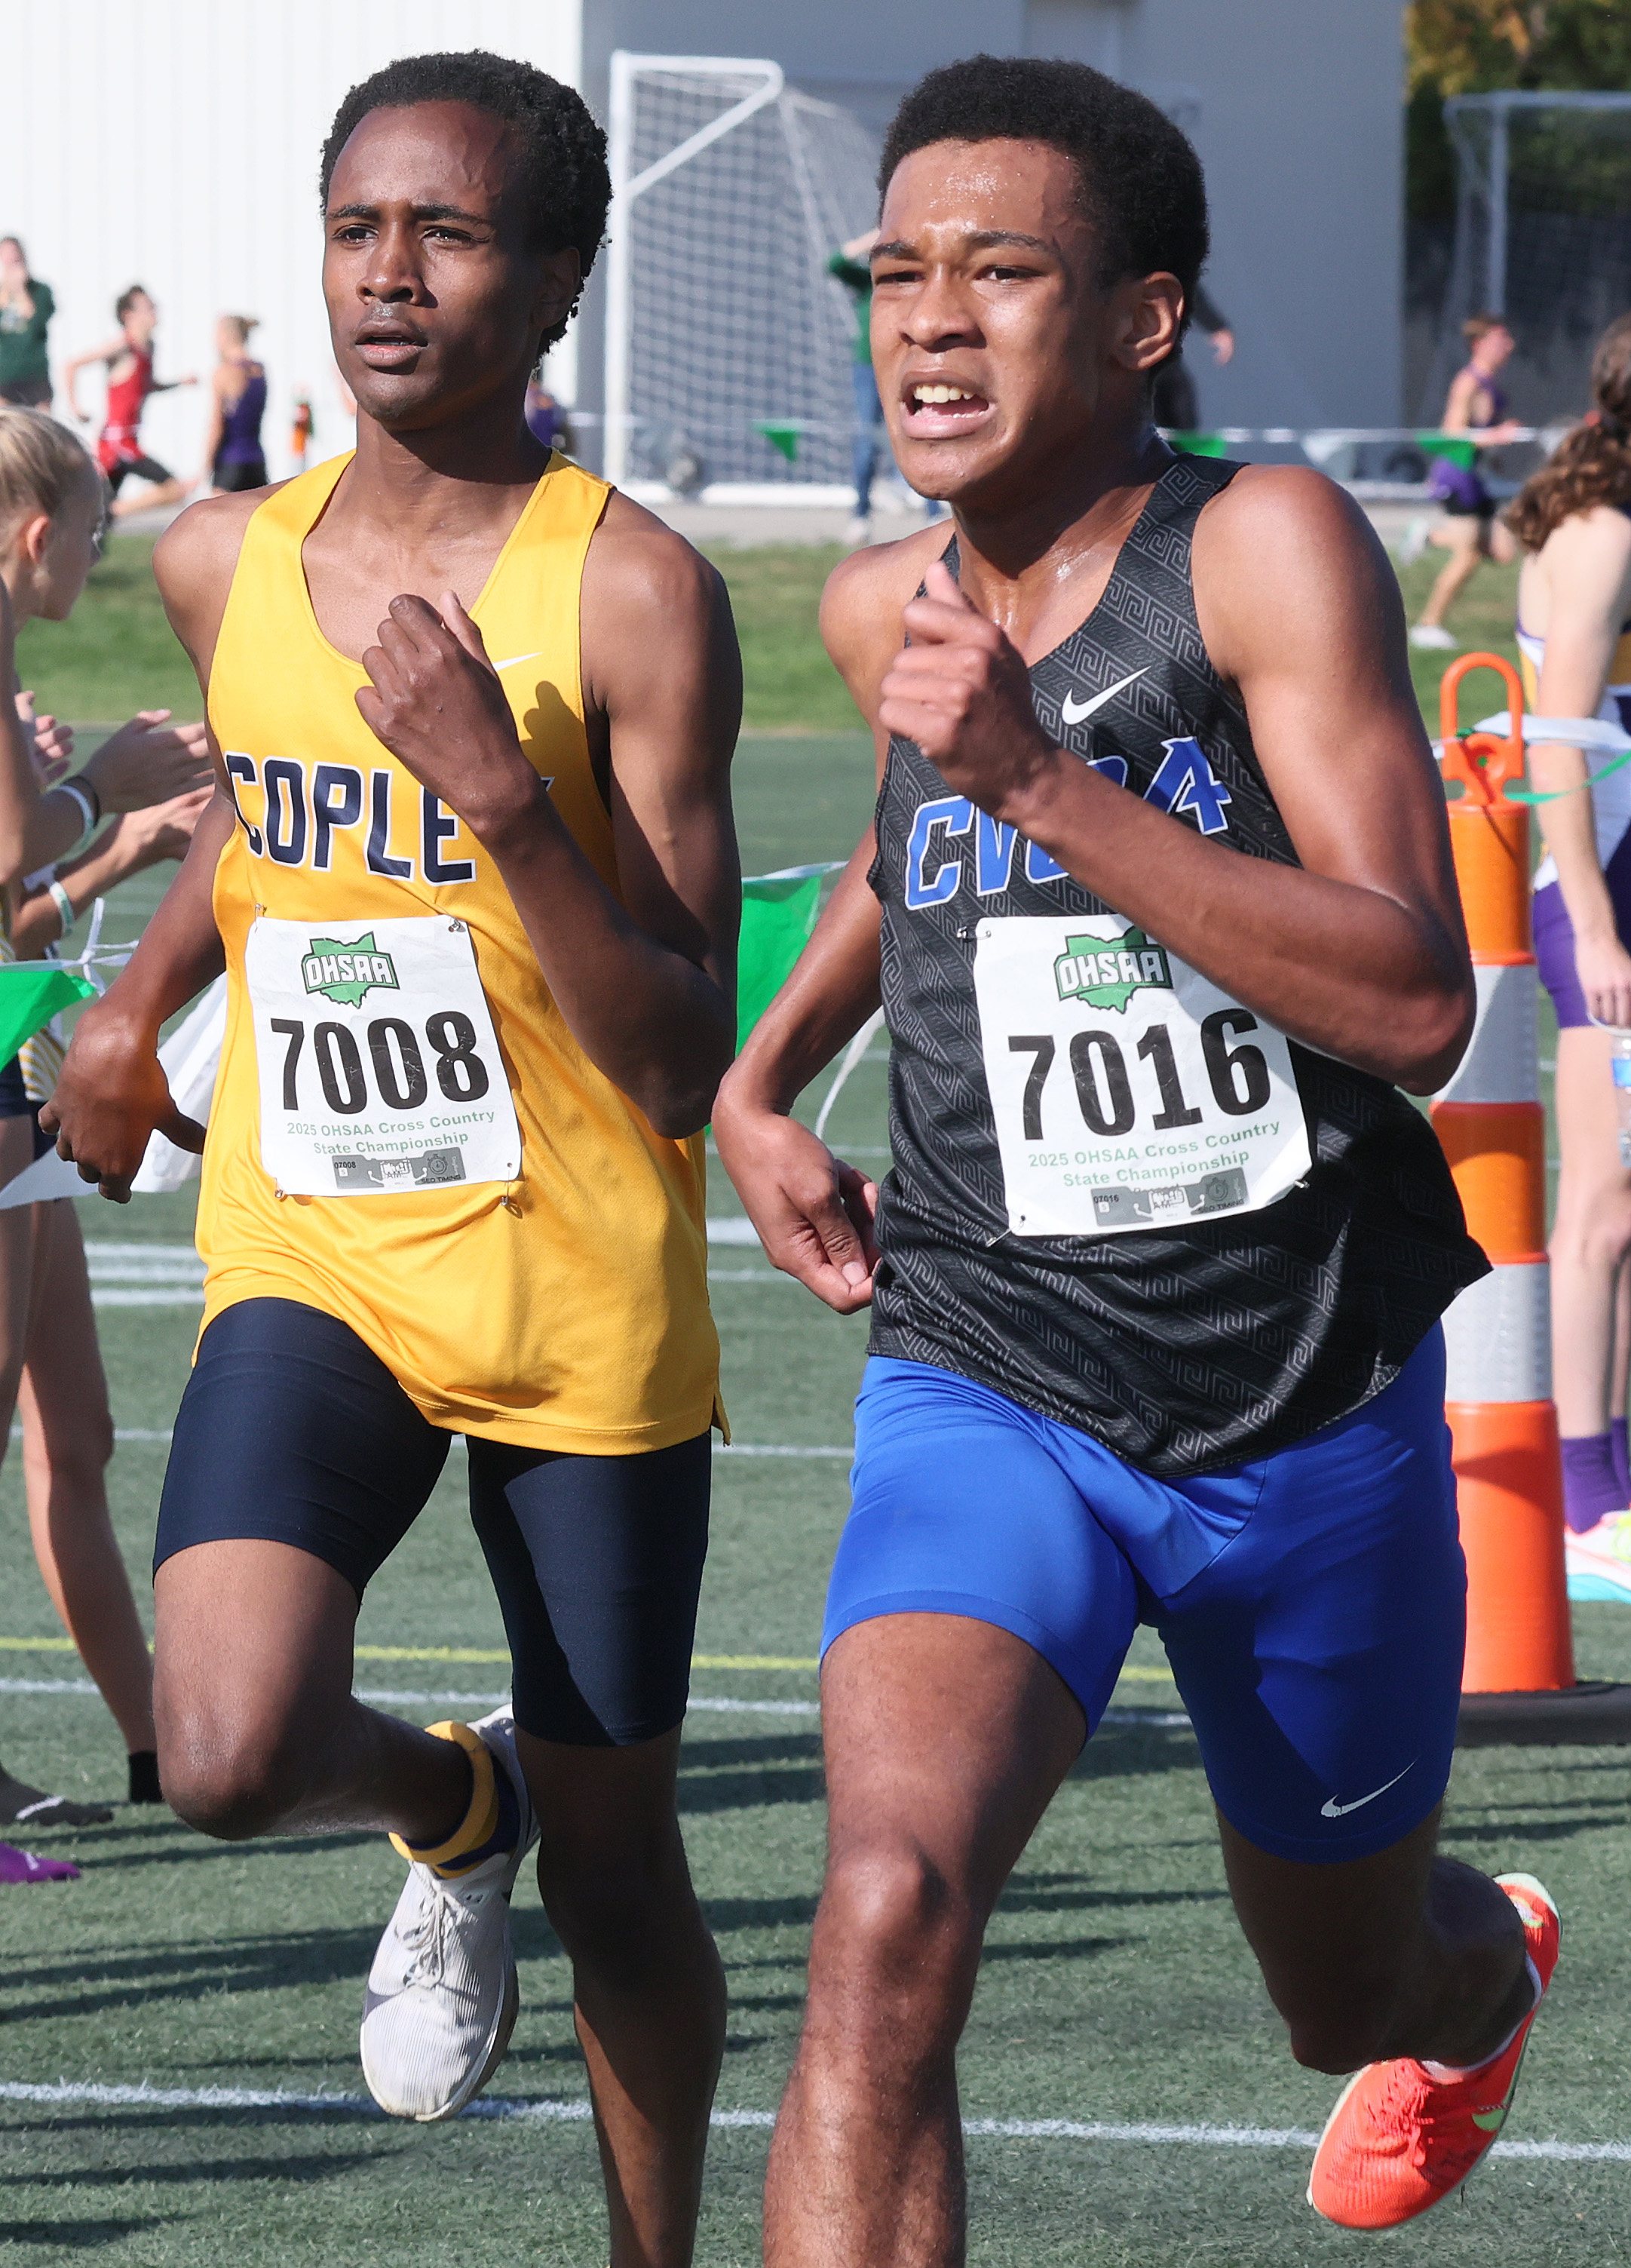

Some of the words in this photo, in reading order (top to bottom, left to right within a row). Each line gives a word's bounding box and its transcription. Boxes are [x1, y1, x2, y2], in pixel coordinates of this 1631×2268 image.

[225, 750, 555, 887] COPLE
[305, 953, 393, 989] OHSAA
[1058, 951, 1166, 993] OHSAA
[271, 1011, 489, 1115] 7008
[1007, 1008, 1271, 1140] 7016
[287, 1122, 317, 1136] 2025
[320, 1122, 375, 1137] OHSAA
[379, 1119, 425, 1135] Cross
[429, 1111, 496, 1129] Country
[314, 1142, 351, 1155] State
[356, 1132, 469, 1154] Championship
[1028, 1152, 1069, 1168] 2025
[1074, 1147, 1139, 1165] OHSAA
[1145, 1140, 1199, 1159] Cross
[1205, 1120, 1281, 1149] Country
[1063, 1171, 1111, 1188] State
[1116, 1149, 1250, 1183] Championship
